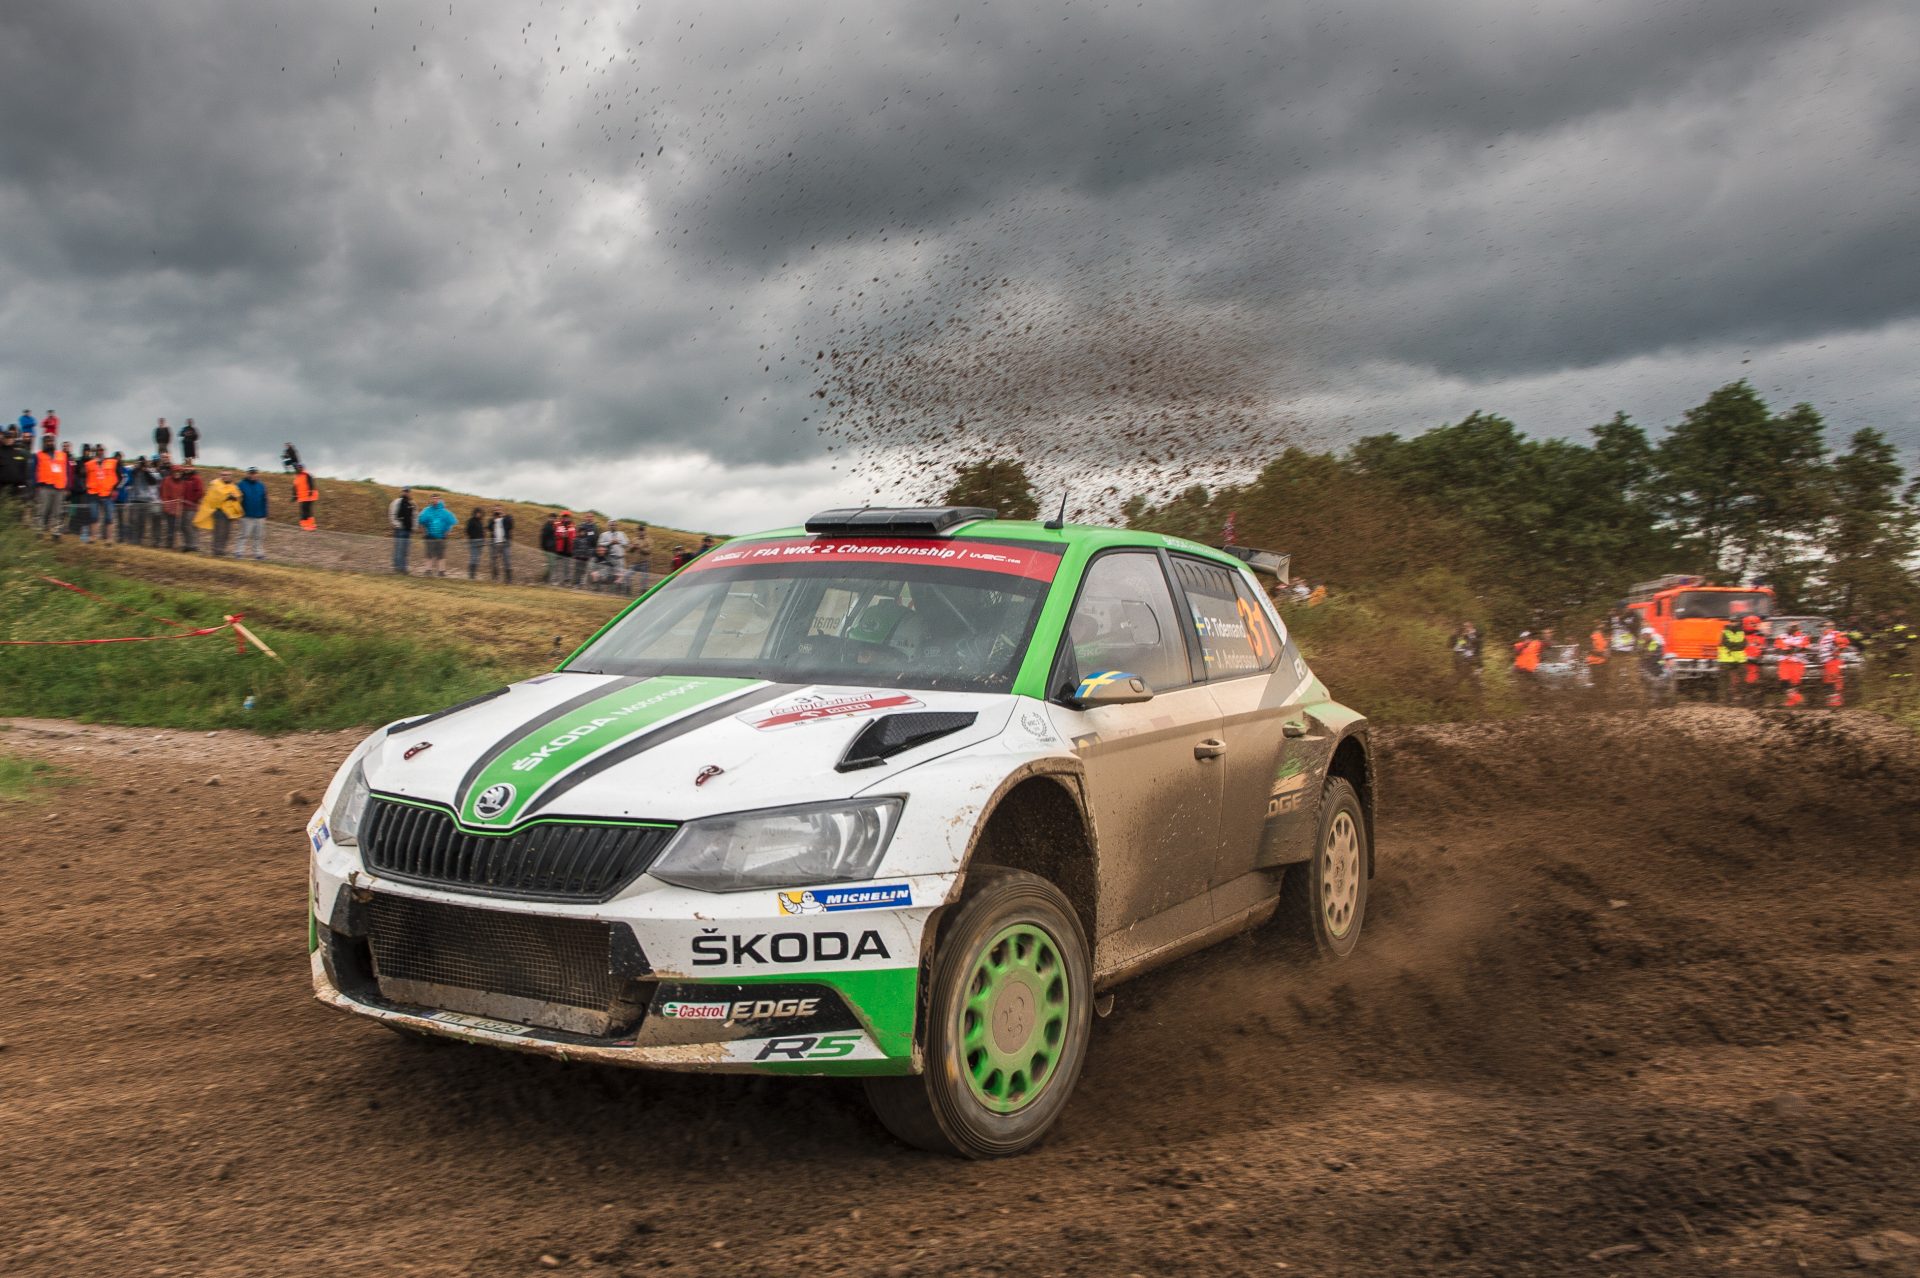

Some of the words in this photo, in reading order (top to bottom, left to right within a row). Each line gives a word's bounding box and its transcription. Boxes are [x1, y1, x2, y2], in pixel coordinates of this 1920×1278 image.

[753, 547, 780, 558] FIA
[783, 545, 818, 555] WRC
[820, 544, 835, 554] 2
[837, 544, 956, 560] Championship
[512, 717, 613, 772] ŠKODA
[825, 889, 910, 904] MICHELIN
[692, 928, 891, 966] ŠKODA
[678, 1004, 725, 1018] Castrol
[732, 998, 822, 1020] EDGE
[754, 1035, 863, 1061] R5
